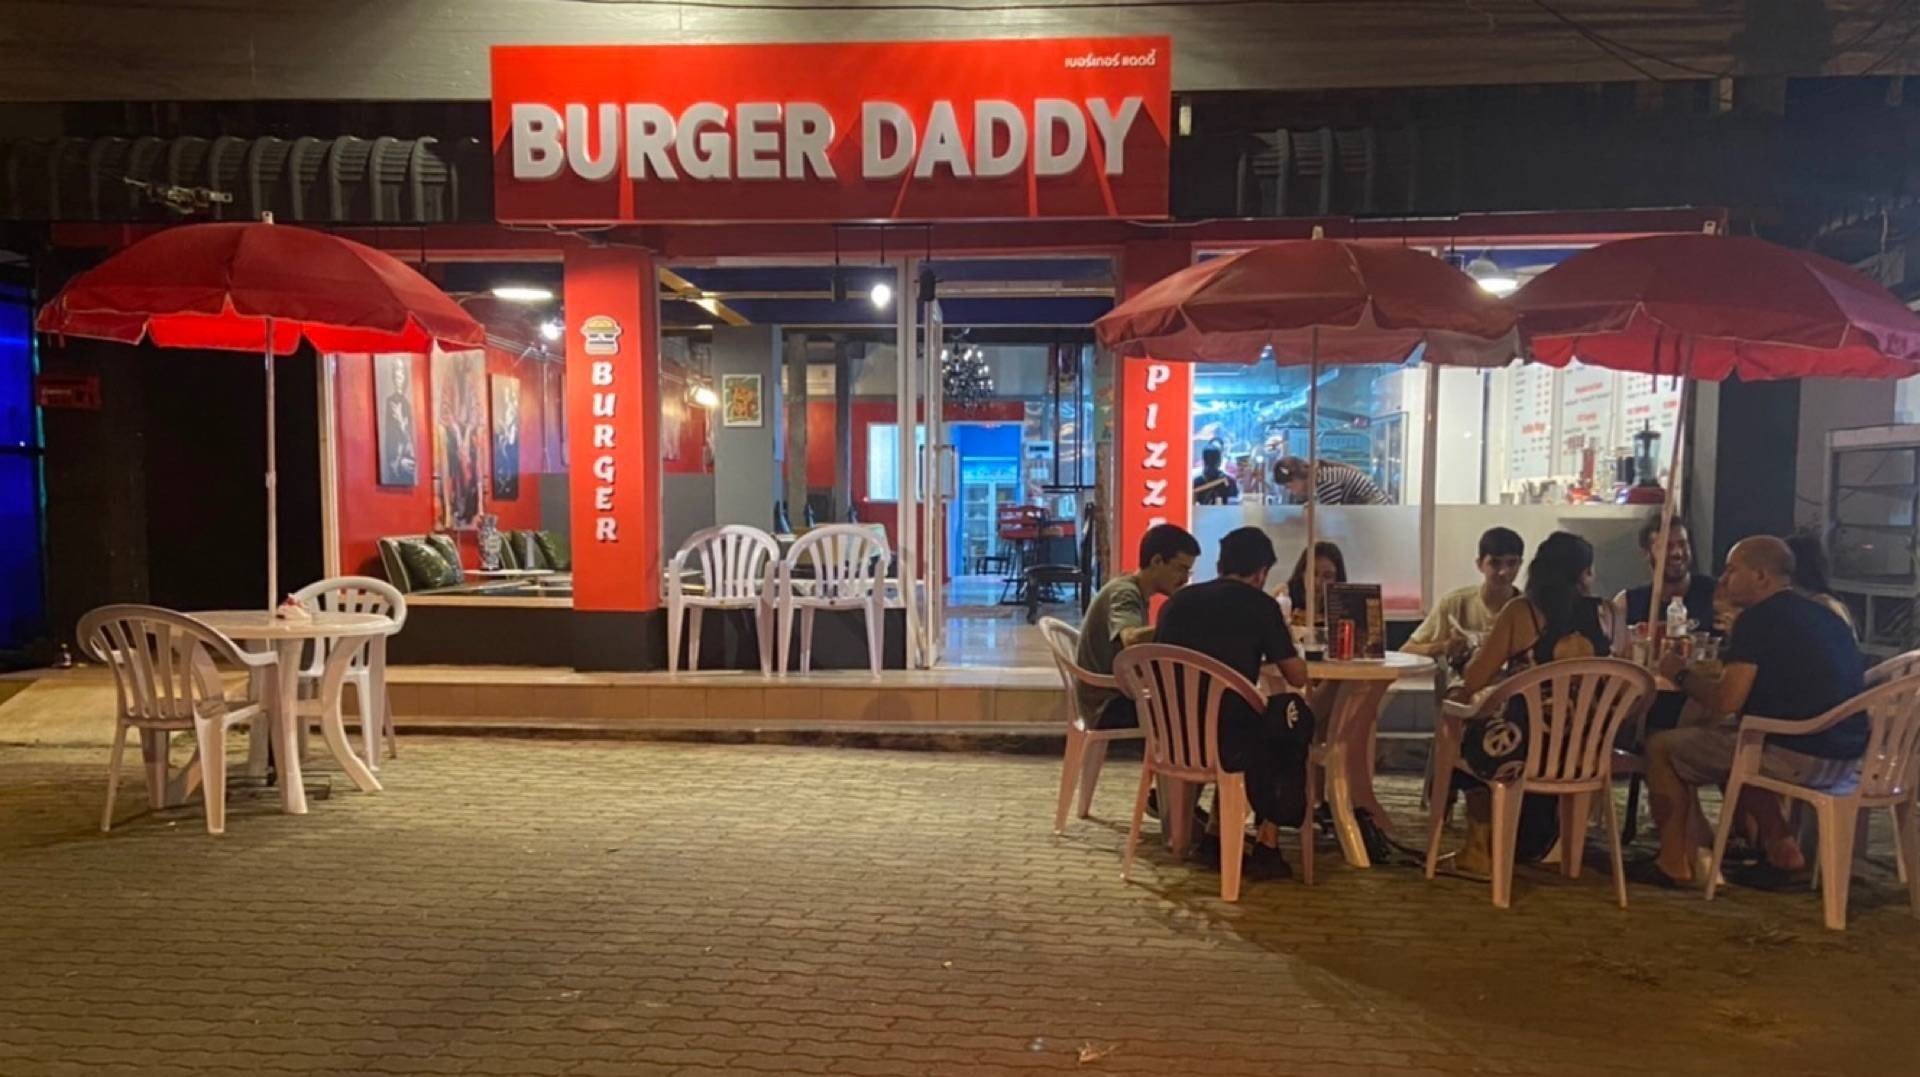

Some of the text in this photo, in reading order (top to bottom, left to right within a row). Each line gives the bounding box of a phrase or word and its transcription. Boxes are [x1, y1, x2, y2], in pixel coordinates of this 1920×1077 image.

[510, 96, 1143, 180] BURGER DADDY
[591, 361, 617, 541] BURGER
